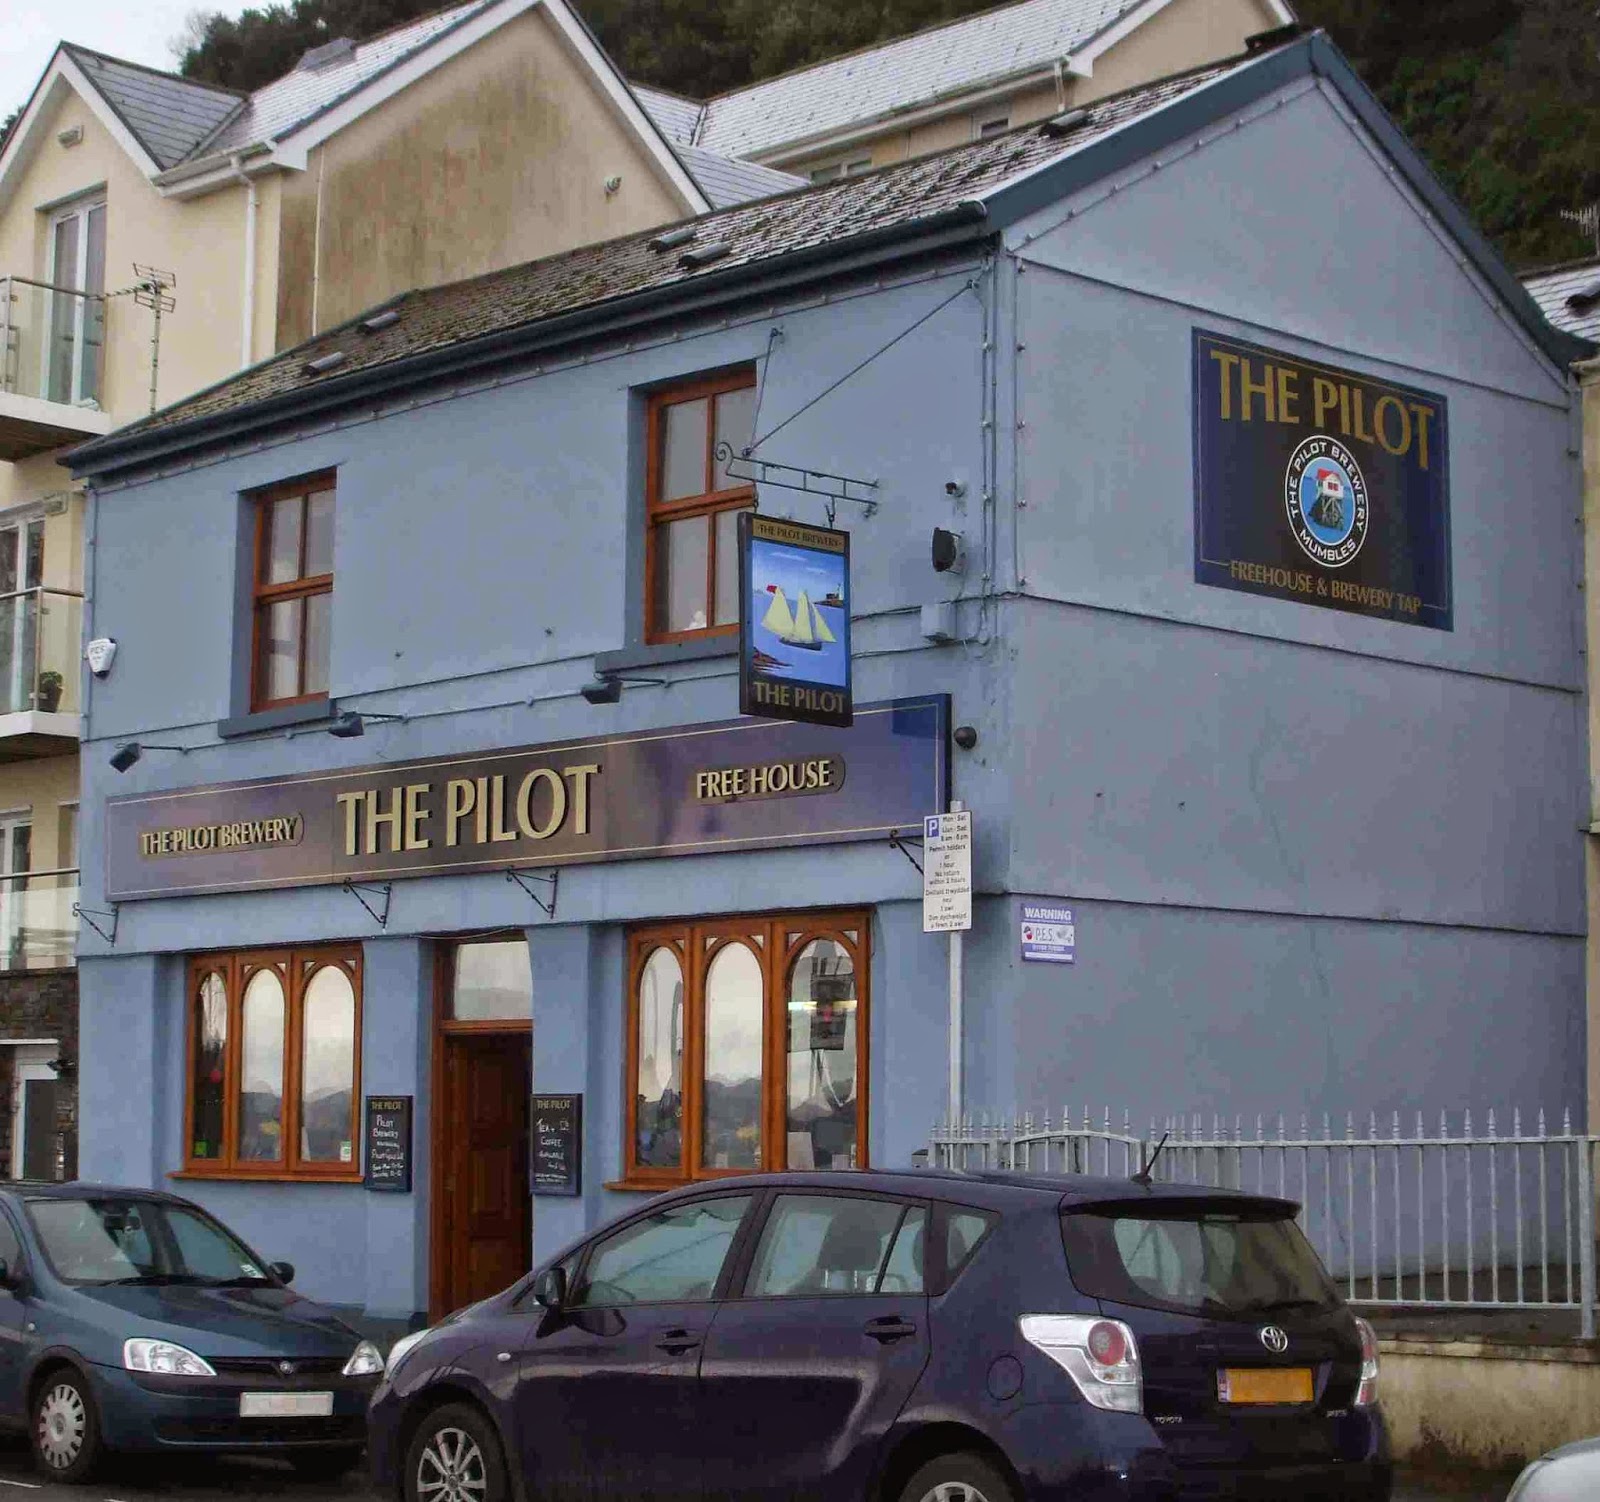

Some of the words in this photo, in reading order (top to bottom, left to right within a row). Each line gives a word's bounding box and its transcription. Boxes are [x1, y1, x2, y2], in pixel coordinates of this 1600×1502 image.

[1210, 349, 1300, 424] THE
[1313, 377, 1434, 471] PILOT
[1289, 476, 1299, 519] THE
[1294, 442, 1327, 471] PILOT
[1331, 446, 1365, 531] BREWERY
[760, 525, 775, 536] THE
[777, 527, 800, 540] PILOT
[803, 532, 839, 547] BREWERY
[1300, 529, 1356, 561] MUMBLES
[1231, 560, 1313, 593] FREEHOUSE
[1317, 577, 1328, 597] &
[1331, 580, 1393, 608] BREWERY
[1396, 593, 1421, 615] TAP
[754, 682, 790, 706] THE
[794, 688, 844, 714] PILOT
[696, 768, 746, 799] FREE
[750, 760, 832, 793] HOUSE
[337, 783, 431, 856] THE
[446, 764, 600, 847] PILOT
[141, 831, 171, 855] THE
[173, 826, 218, 851] PILOT
[220, 817, 297, 847] BREWERY
[928, 820, 938, 837] P
[1025, 907, 1072, 921] WARNING
[371, 1101, 385, 1110] THE
[385, 1101, 402, 1110] PILOT
[537, 1100, 549, 1109] THE
[551, 1100, 570, 1110] PILOT
[1154, 1416, 1183, 1424] TOYOTA
